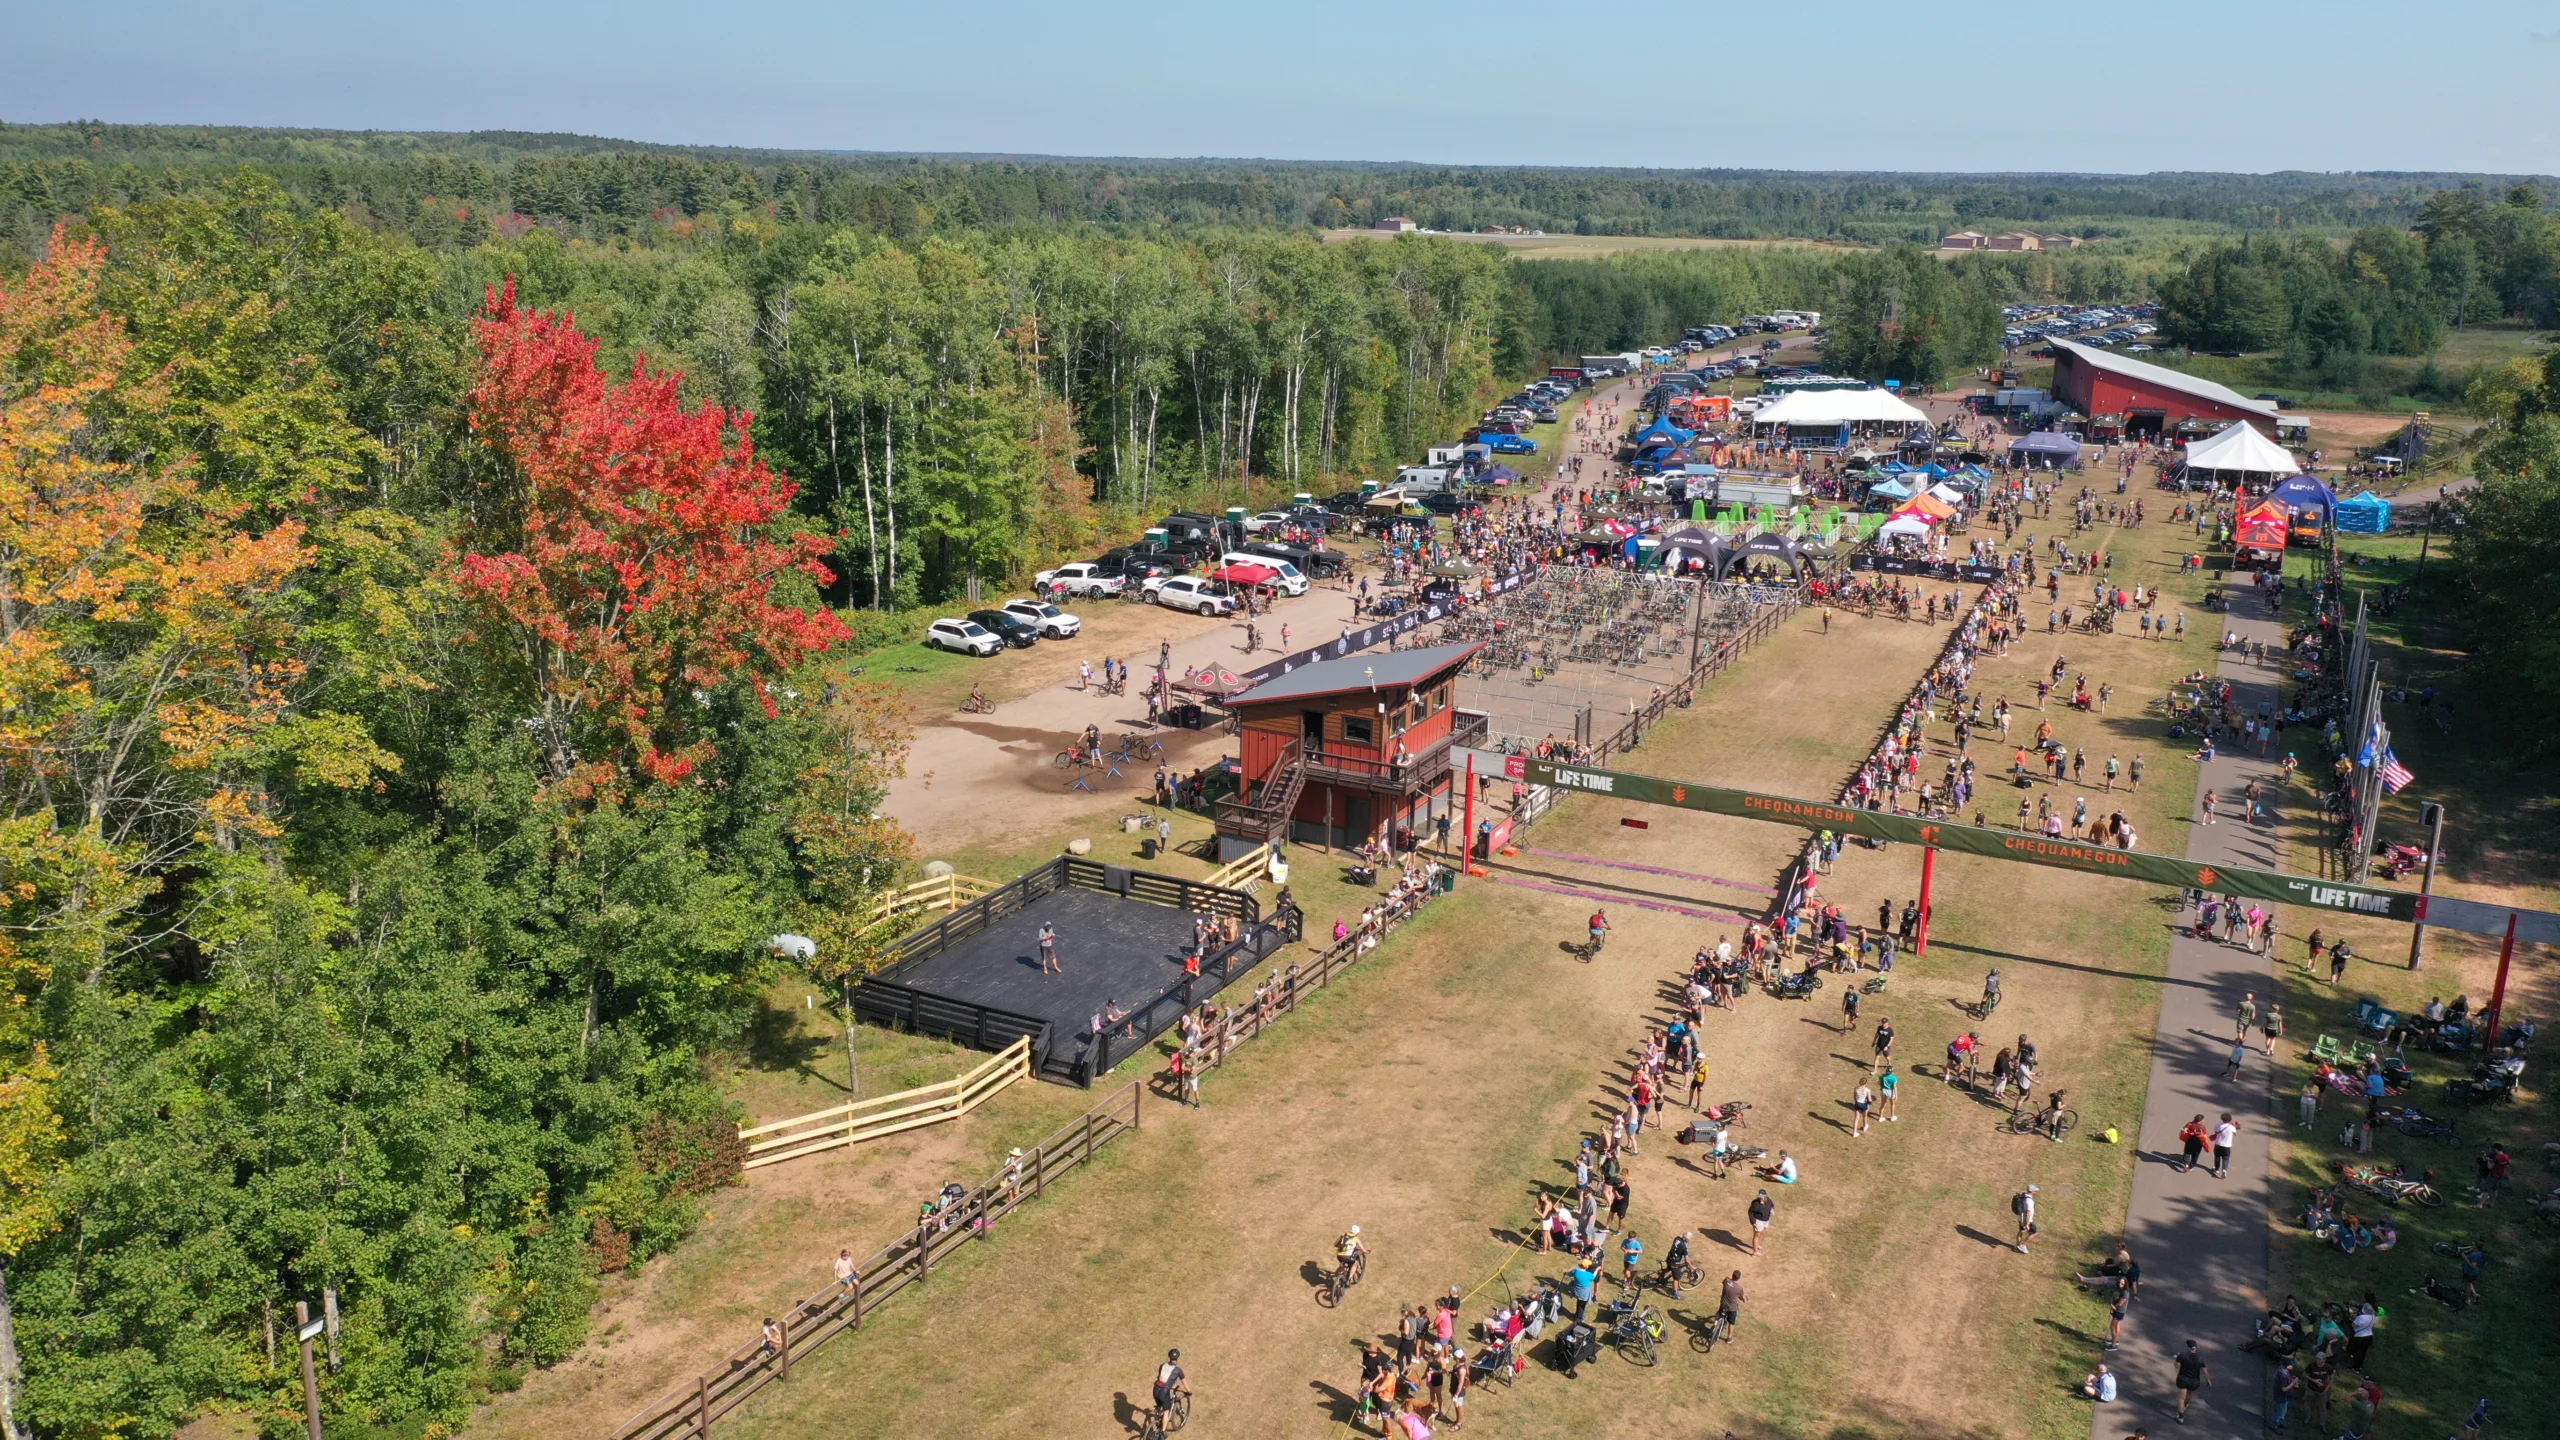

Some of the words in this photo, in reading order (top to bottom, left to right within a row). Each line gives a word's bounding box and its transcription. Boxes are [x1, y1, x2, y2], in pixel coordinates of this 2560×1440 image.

[1554, 768, 1581, 787] LIFE
[1581, 772, 1614, 792] TIME
[1744, 796, 1855, 823] CHEQUAMEGON
[2005, 837, 2129, 866] CHEQUAMEGON
[2310, 886, 2346, 907] LIFE
[2347, 891, 2391, 913] TIME
